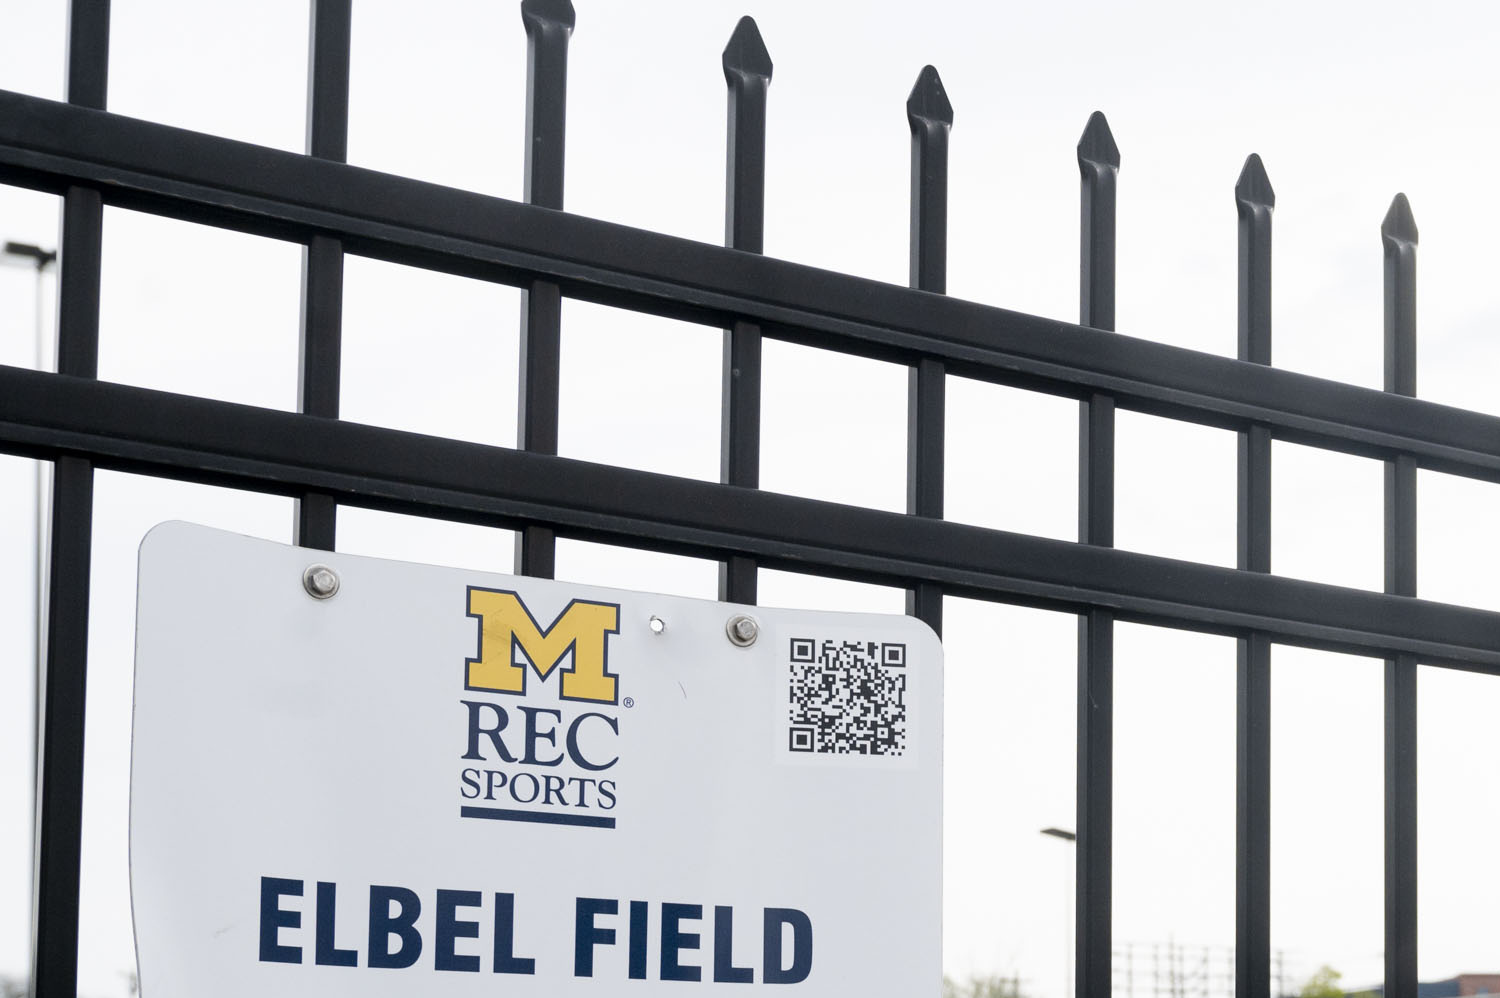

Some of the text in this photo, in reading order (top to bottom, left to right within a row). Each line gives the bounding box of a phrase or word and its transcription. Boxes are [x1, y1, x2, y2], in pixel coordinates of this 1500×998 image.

[464, 585, 620, 706] M
[460, 700, 619, 771] REC
[461, 768, 616, 809] SPORTS
[259, 876, 814, 985] ELBEL FIELD
